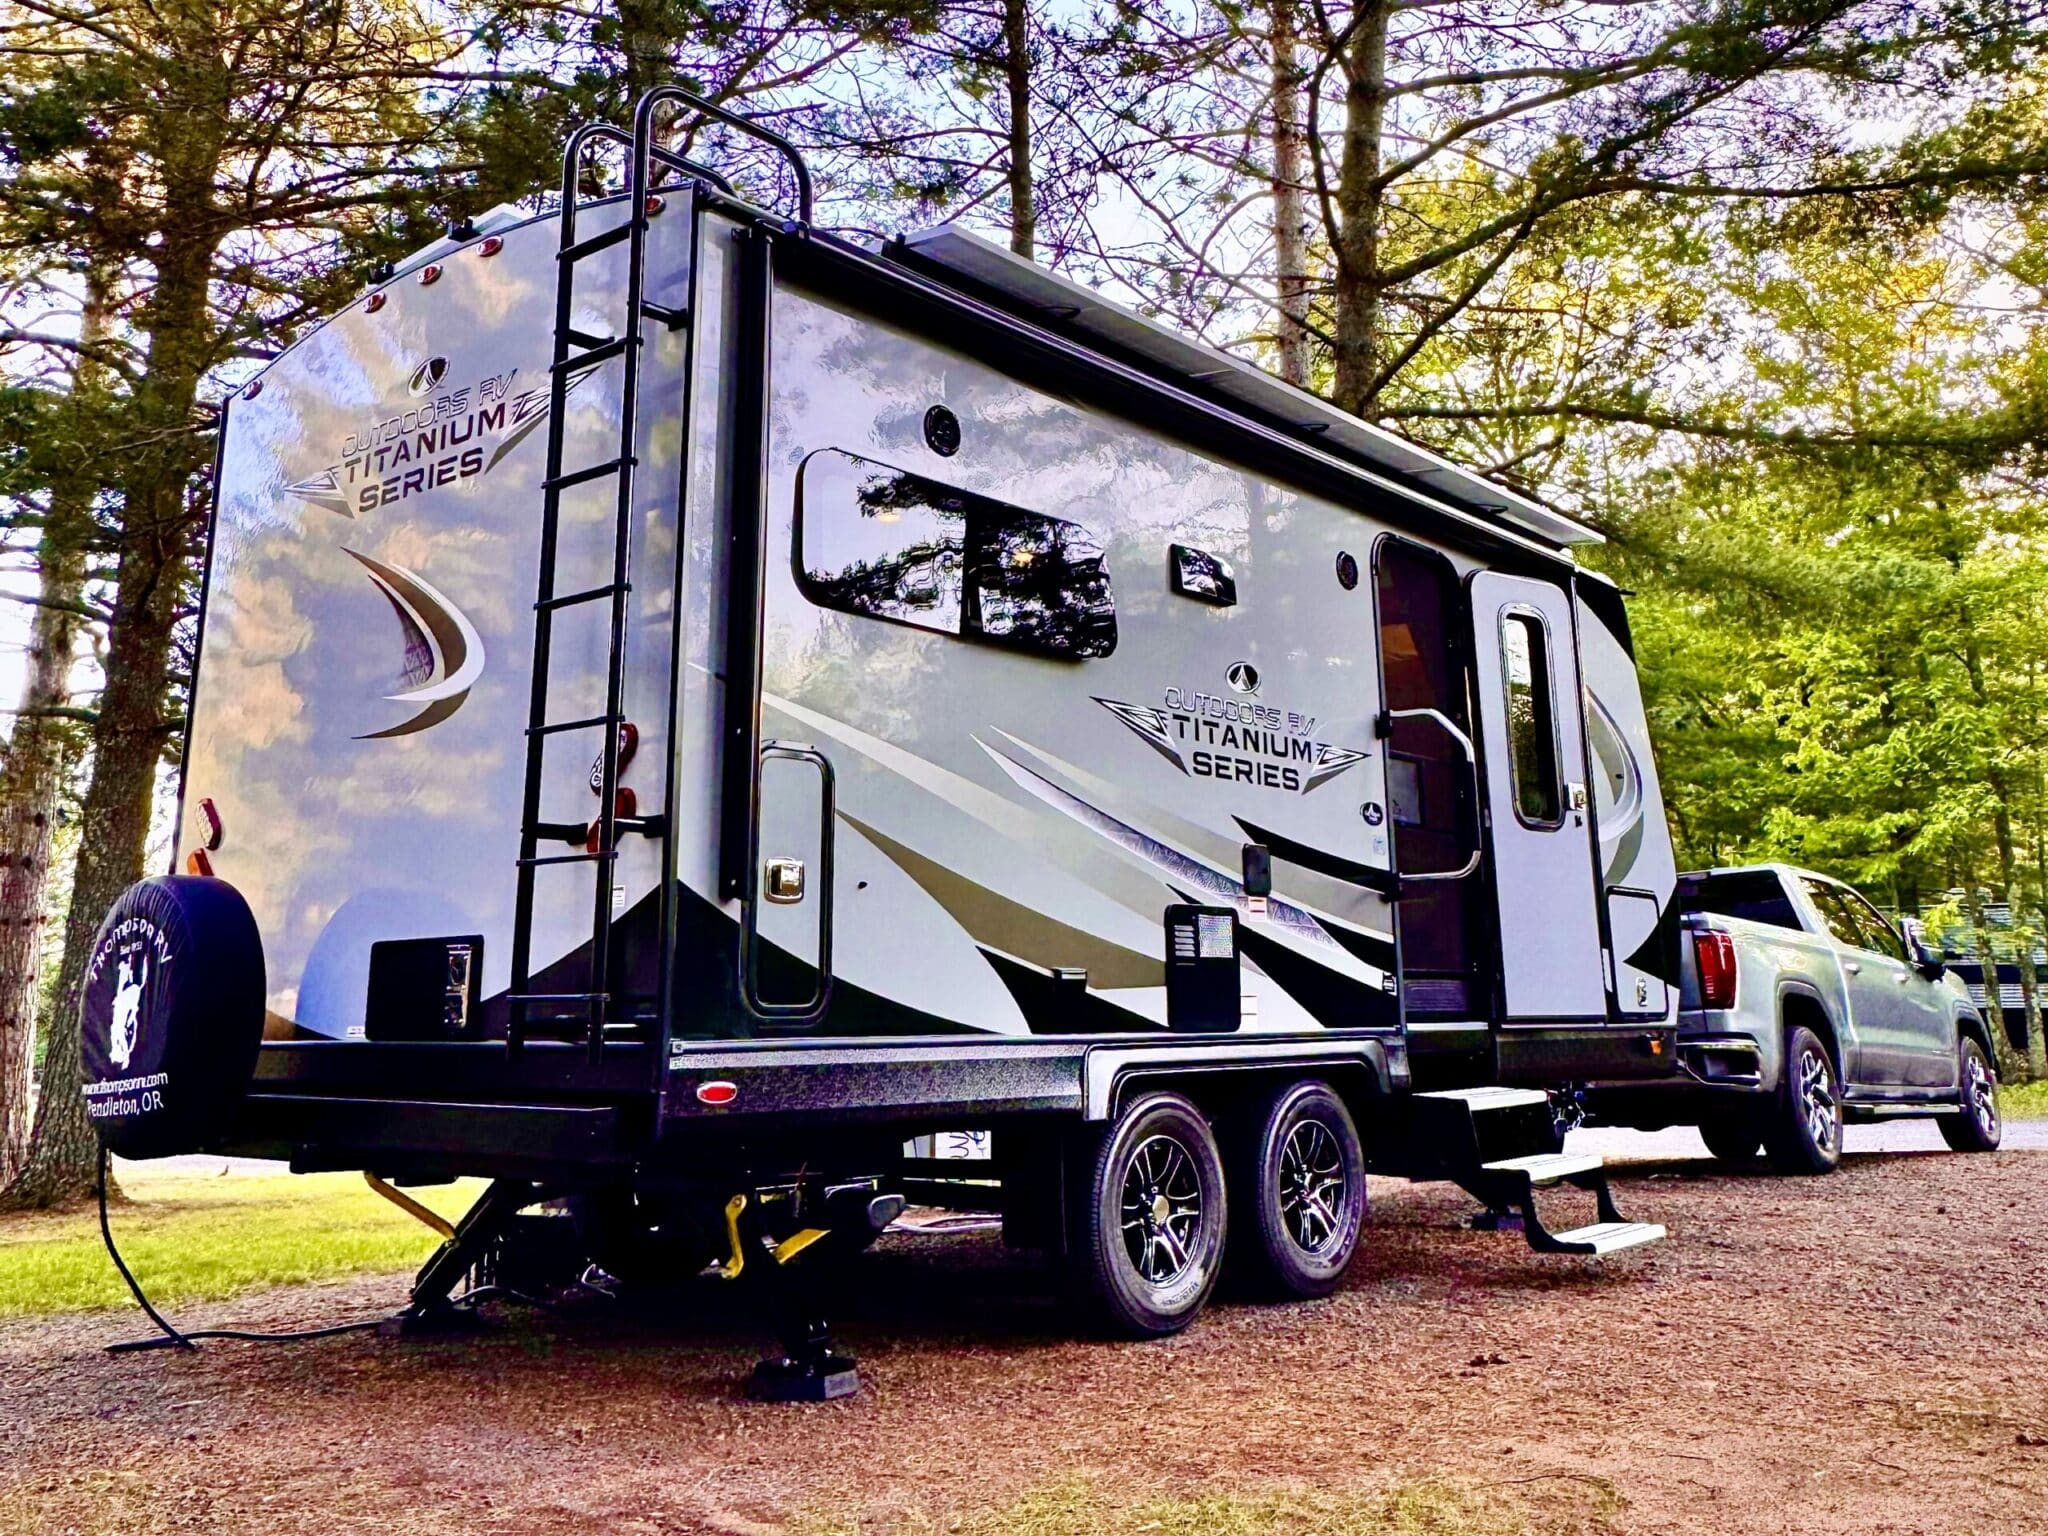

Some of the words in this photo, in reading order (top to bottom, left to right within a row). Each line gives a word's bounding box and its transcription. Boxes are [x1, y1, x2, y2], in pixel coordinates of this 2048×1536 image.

[342, 387, 471, 458] OUTDOORS
[478, 368, 518, 405] RV
[344, 402, 506, 483] TITANIUM
[358, 447, 484, 512] SERIES
[1164, 686, 1281, 730] OUTDOORS
[1173, 714, 1312, 763] TITANIUM
[1192, 751, 1300, 791] SERIES
[87, 1096, 140, 1117] Pendleton,
[142, 1090, 164, 1111] OR
